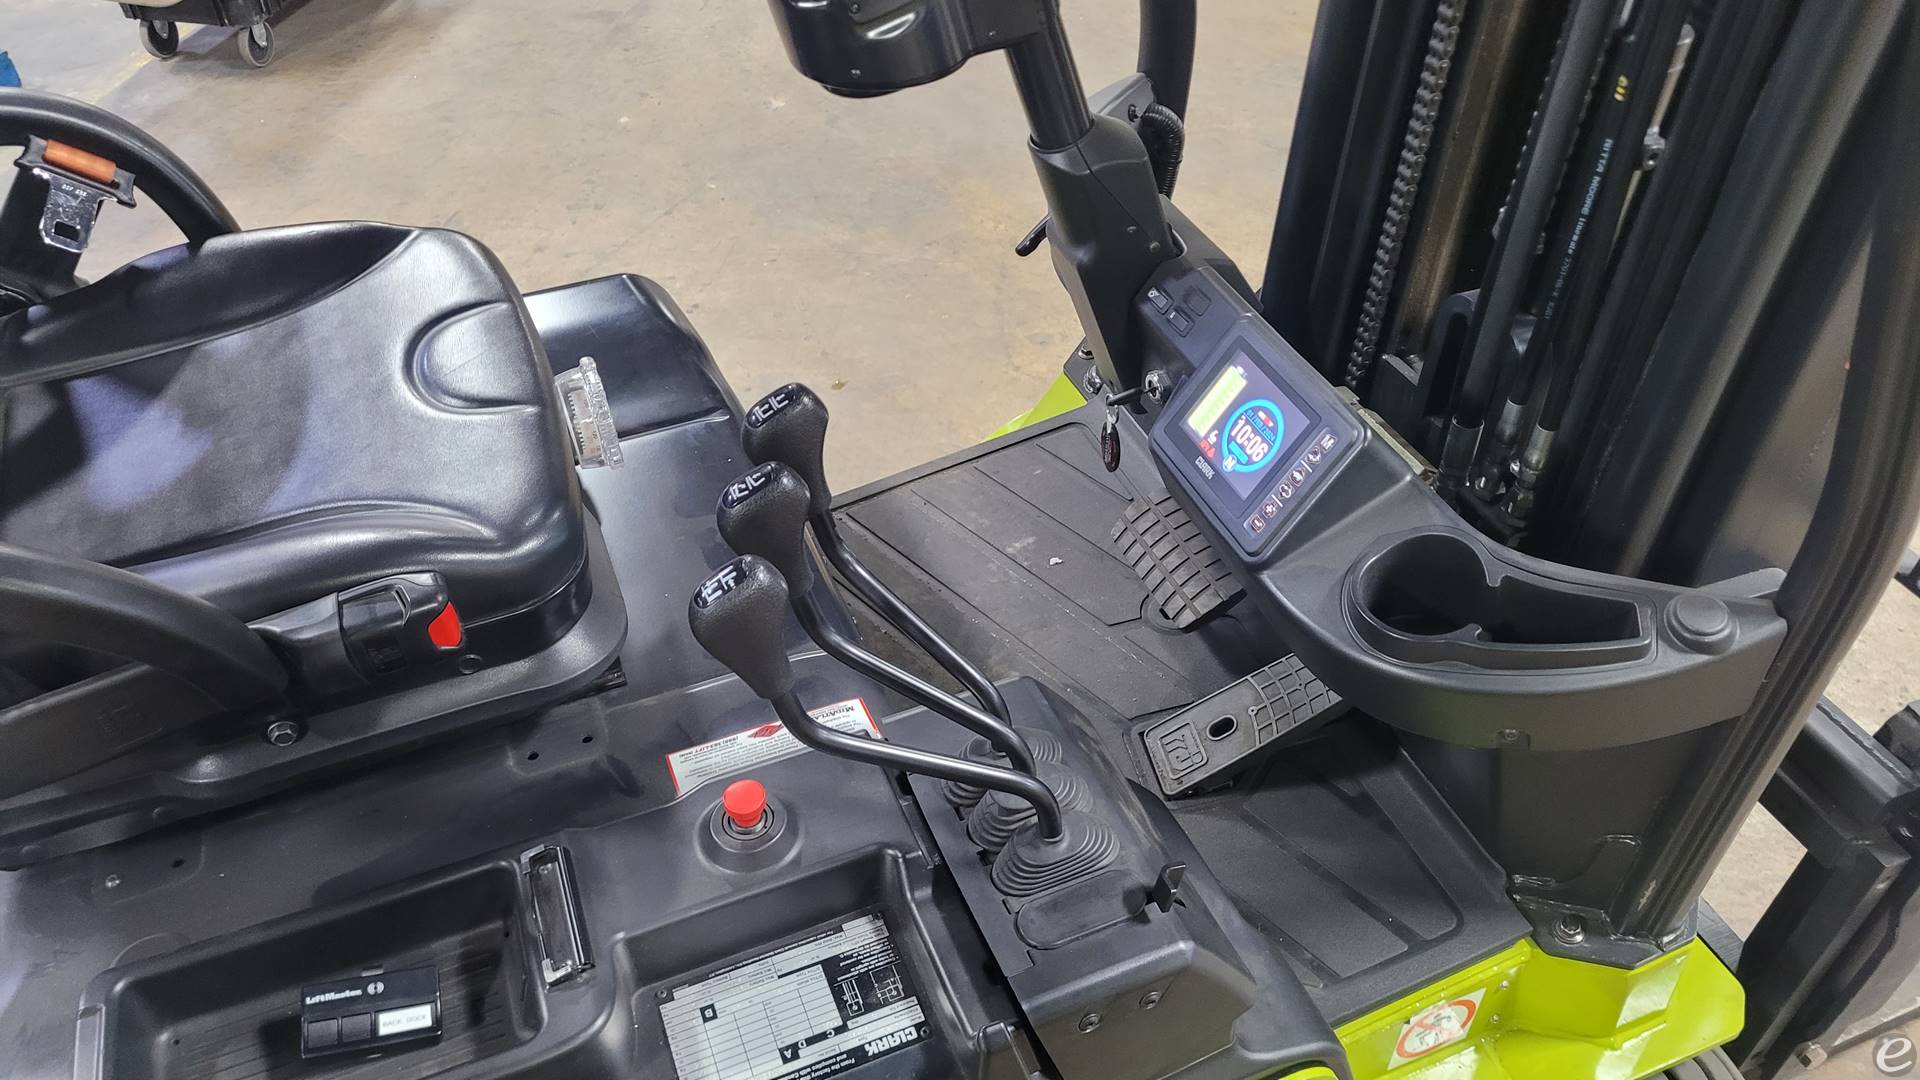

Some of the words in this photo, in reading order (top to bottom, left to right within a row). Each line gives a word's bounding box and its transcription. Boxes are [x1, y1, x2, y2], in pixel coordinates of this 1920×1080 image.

[1596, 138, 1613, 173] NITTA
[1581, 175, 1601, 215] MOORE
[1231, 415, 1269, 462] 10:06
[1195, 456, 1215, 480] CLARK
[704, 1008, 714, 1018] B
[798, 1040, 807, 1049] D
[826, 1029, 835, 1038] C
[864, 1026, 919, 1057] CLARK
[783, 1049, 792, 1059] A
